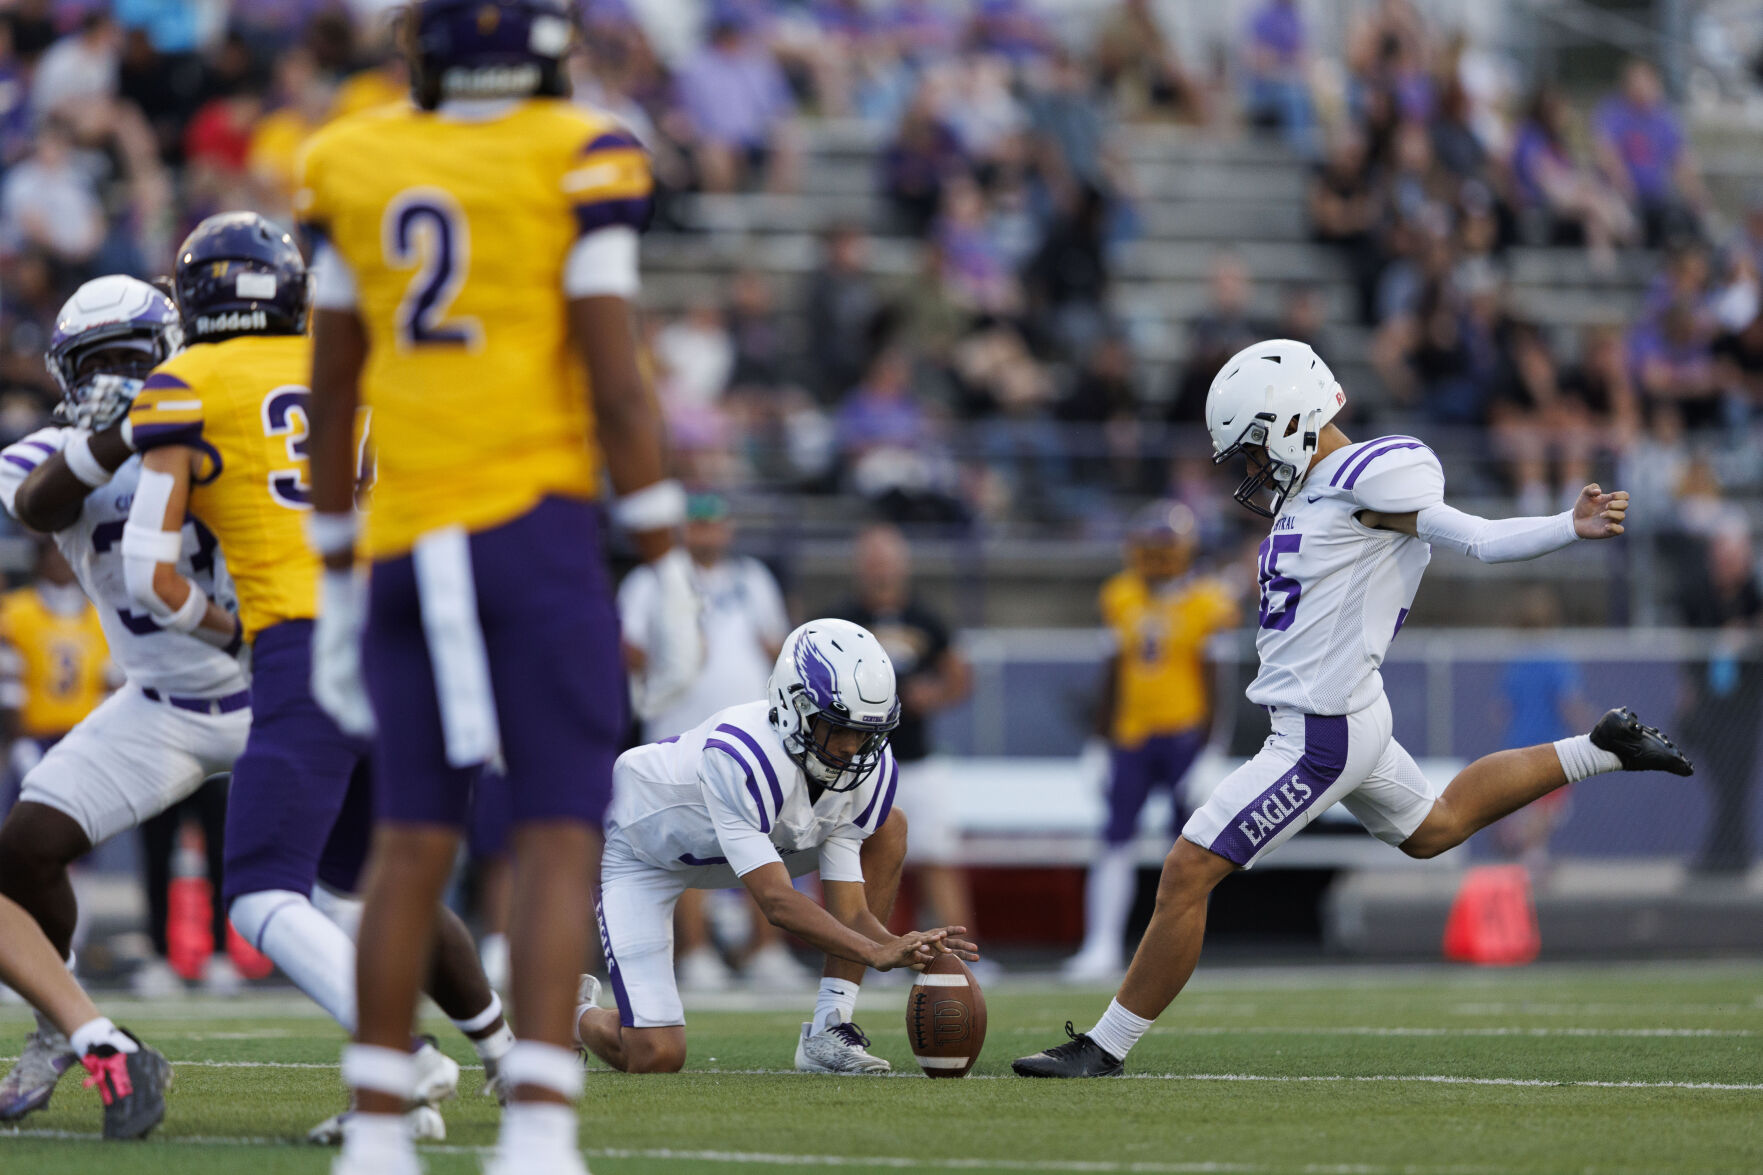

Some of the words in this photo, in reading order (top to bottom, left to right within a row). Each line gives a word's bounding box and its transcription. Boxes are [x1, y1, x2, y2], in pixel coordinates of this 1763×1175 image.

[381, 187, 486, 356] 2
[196, 311, 267, 335] Riddell
[1238, 774, 1312, 847] EAGLES
